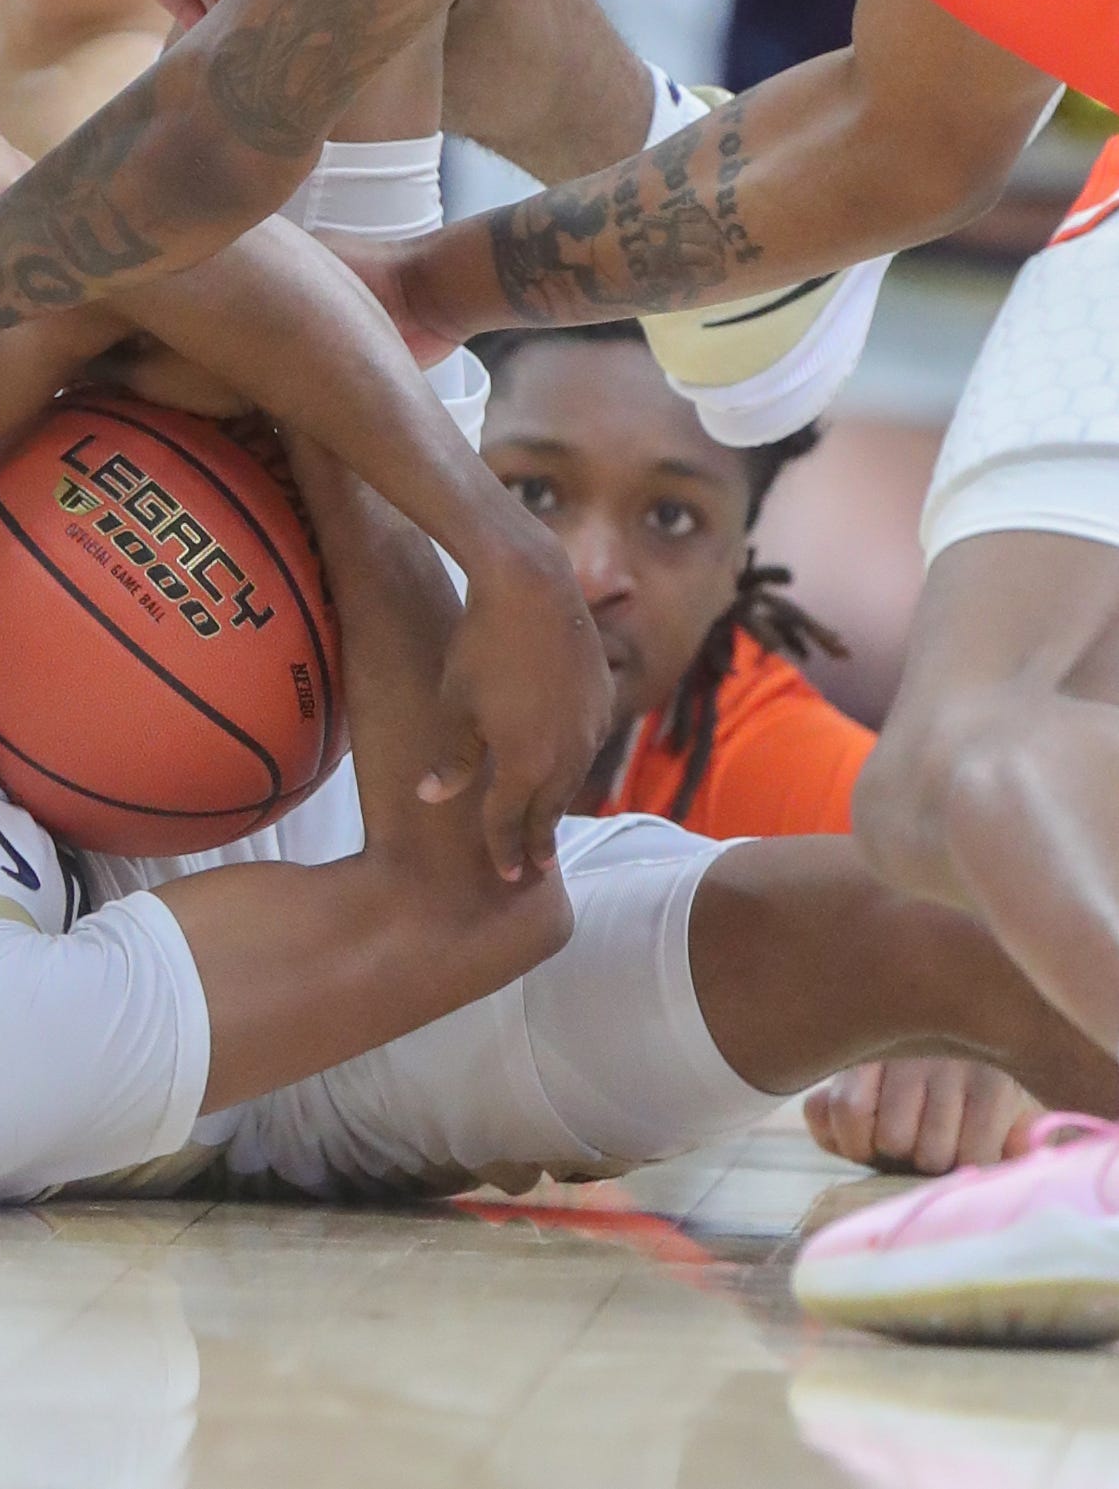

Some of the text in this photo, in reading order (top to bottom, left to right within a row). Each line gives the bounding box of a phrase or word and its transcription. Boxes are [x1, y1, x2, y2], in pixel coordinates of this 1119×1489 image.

[60, 434, 275, 630] LEGACY
[65, 522, 166, 623] OFFICIAL GAME BALL
[91, 509, 221, 639] 1000
